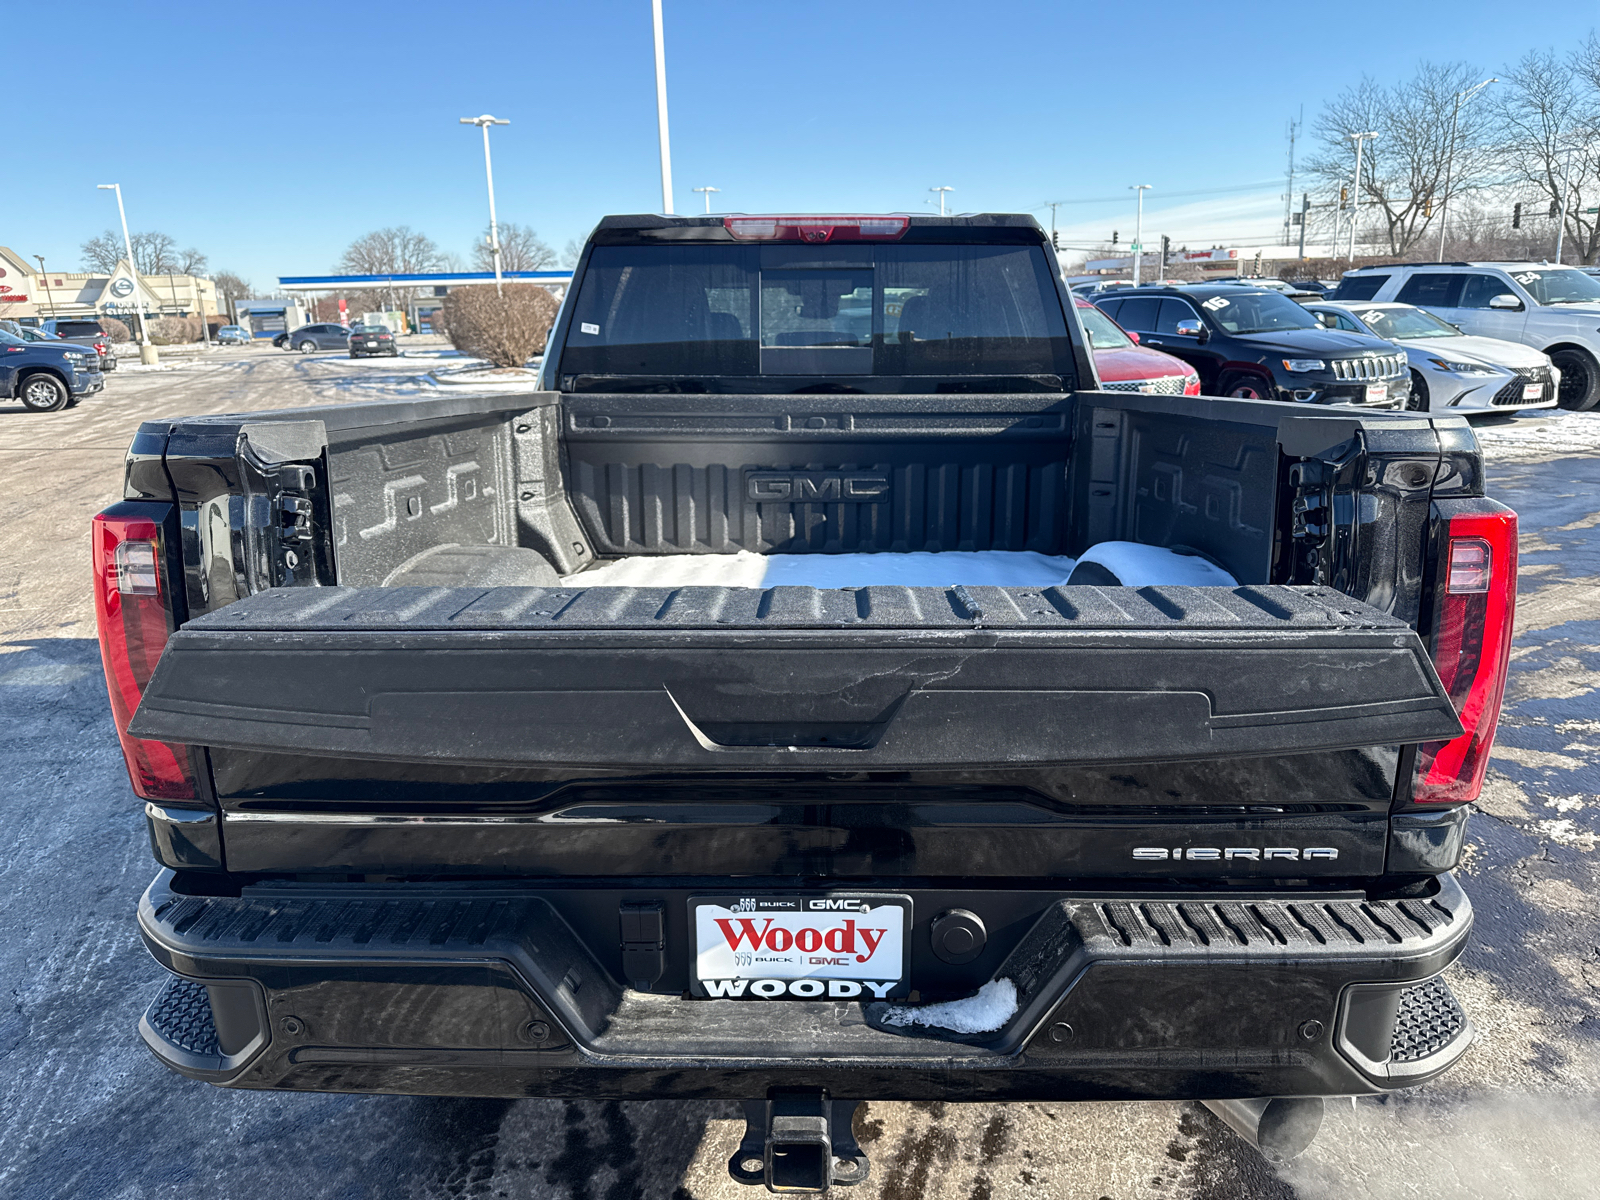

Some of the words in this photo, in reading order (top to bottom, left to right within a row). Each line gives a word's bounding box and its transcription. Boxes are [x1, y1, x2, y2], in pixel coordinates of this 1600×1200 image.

[1514, 271, 1542, 285] 24
[1201, 296, 1231, 311] 16
[1360, 310, 1386, 324] 25
[749, 474, 888, 499] GMC
[1132, 847, 1339, 861] SIERRA
[809, 899, 861, 910] GMC
[713, 918, 888, 963] Woody
[808, 957, 850, 966] GMC
[702, 979, 899, 998] WOODY
